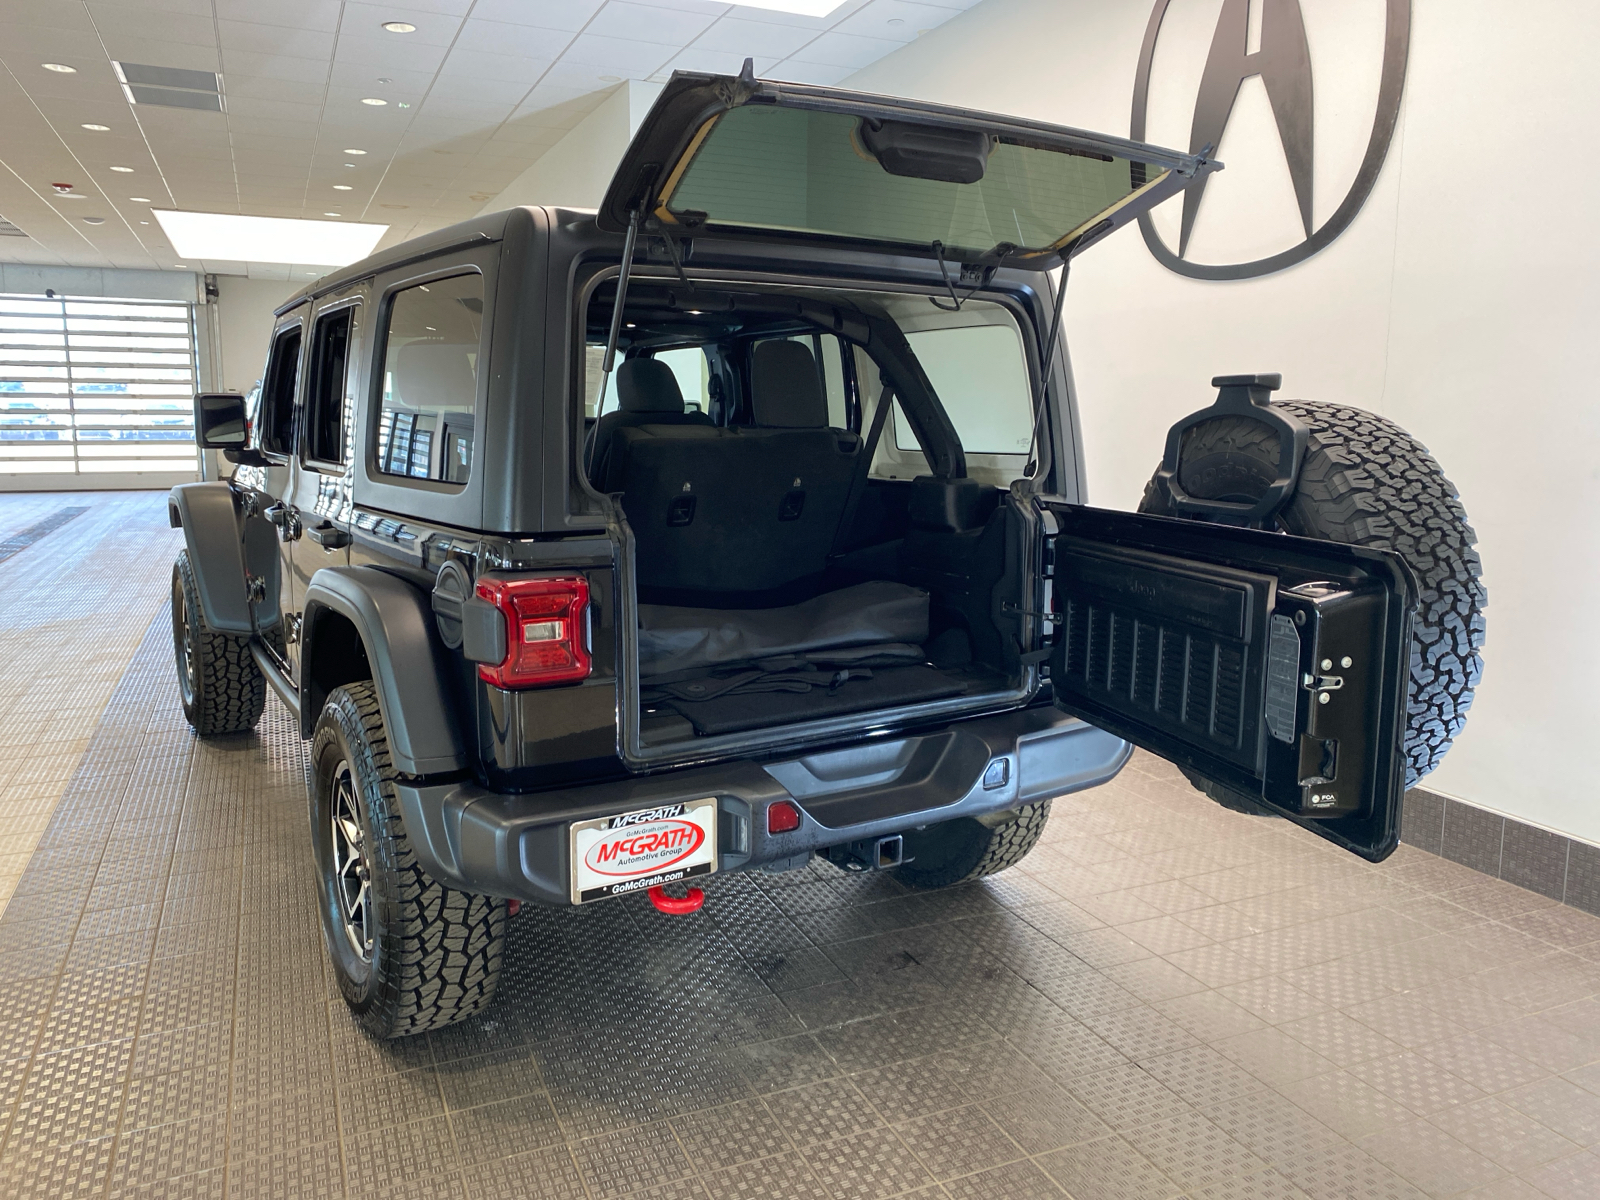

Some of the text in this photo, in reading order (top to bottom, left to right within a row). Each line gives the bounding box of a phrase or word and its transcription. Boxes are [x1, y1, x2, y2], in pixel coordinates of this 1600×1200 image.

[626, 824, 669, 838] GoMcGrath.com
[617, 847, 683, 867] Automotive Group
[611, 870, 684, 895] GoMcGrath.com
